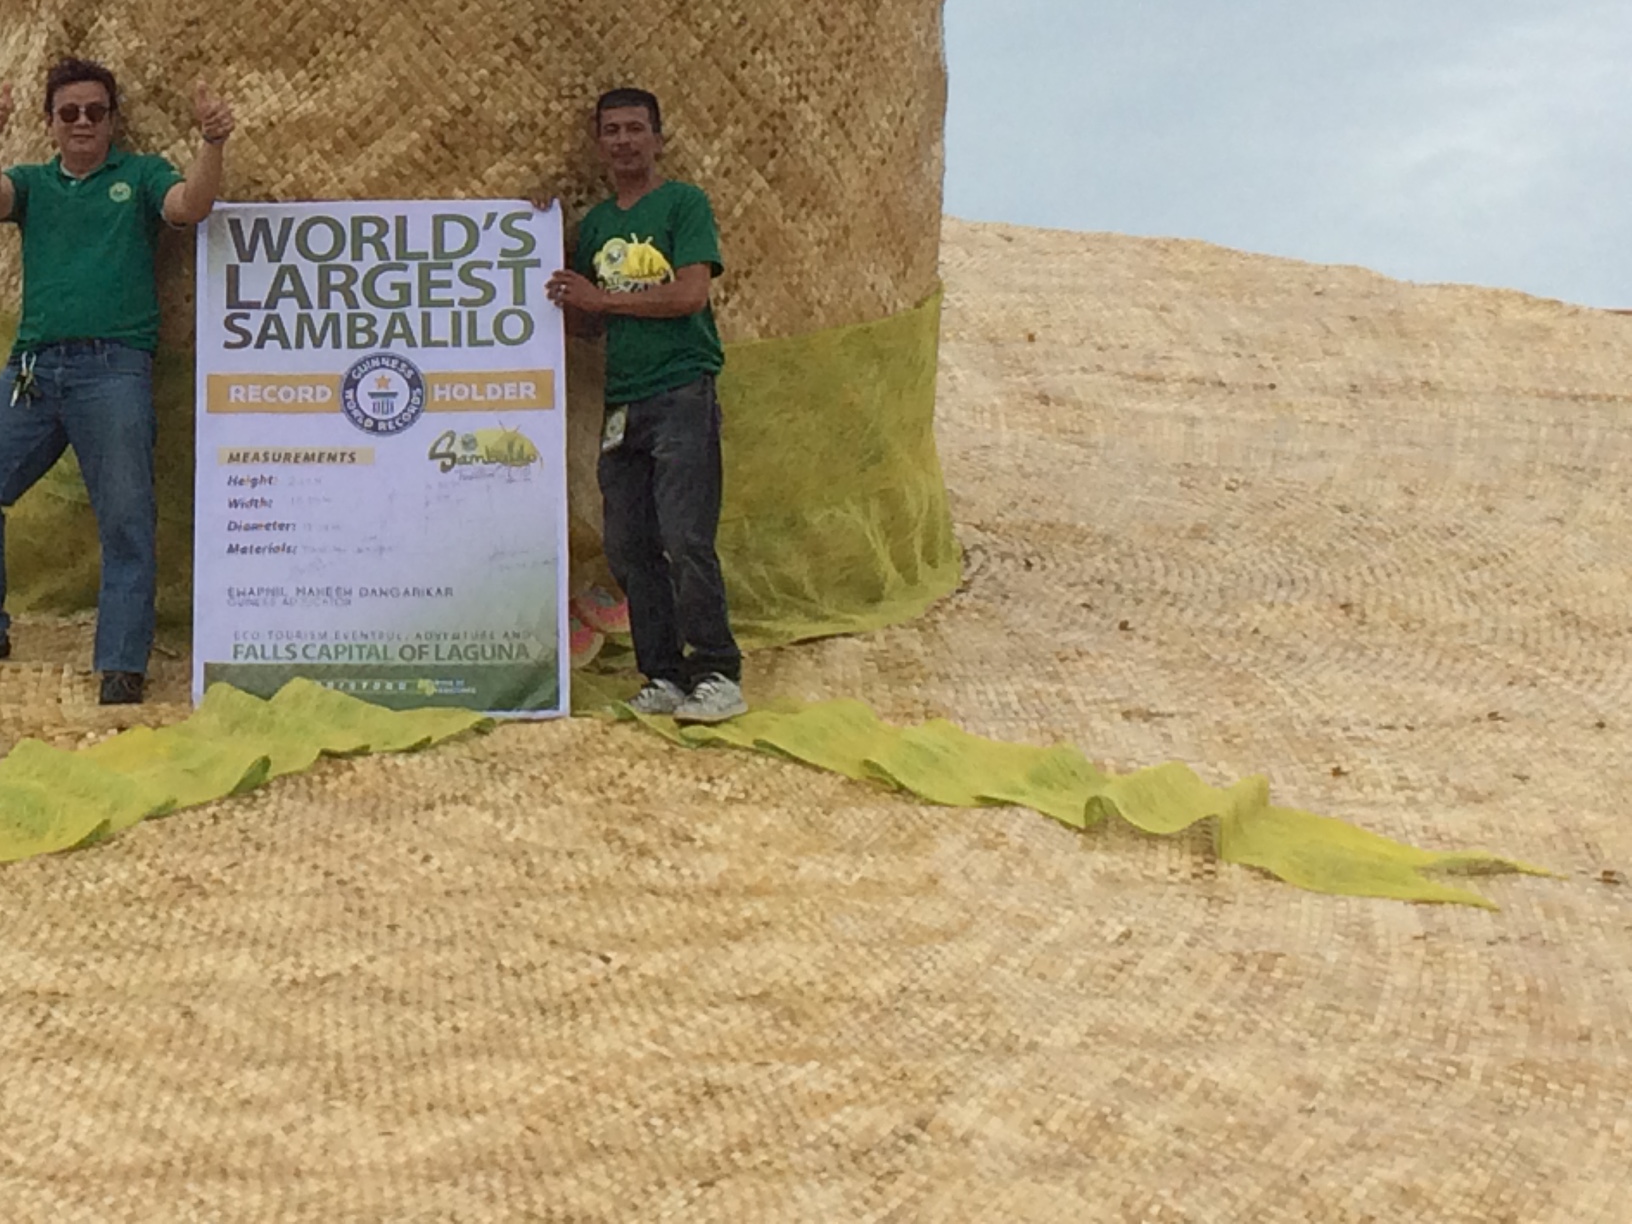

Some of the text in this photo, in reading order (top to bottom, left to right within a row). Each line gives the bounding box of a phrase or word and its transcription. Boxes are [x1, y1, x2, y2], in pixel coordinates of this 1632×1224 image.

[227, 211, 537, 263] WORLD'S
[225, 258, 542, 310] LARGEST
[222, 308, 535, 351] SAMBALILO
[351, 356, 415, 380] GUINNESS
[228, 381, 537, 404] RECORD HOLDER
[344, 387, 422, 431] WORLD RECORDS
[226, 451, 357, 464] MEASUREMENTS
[231, 642, 531, 661] FALLS CAPITAL OF LAGUNA
